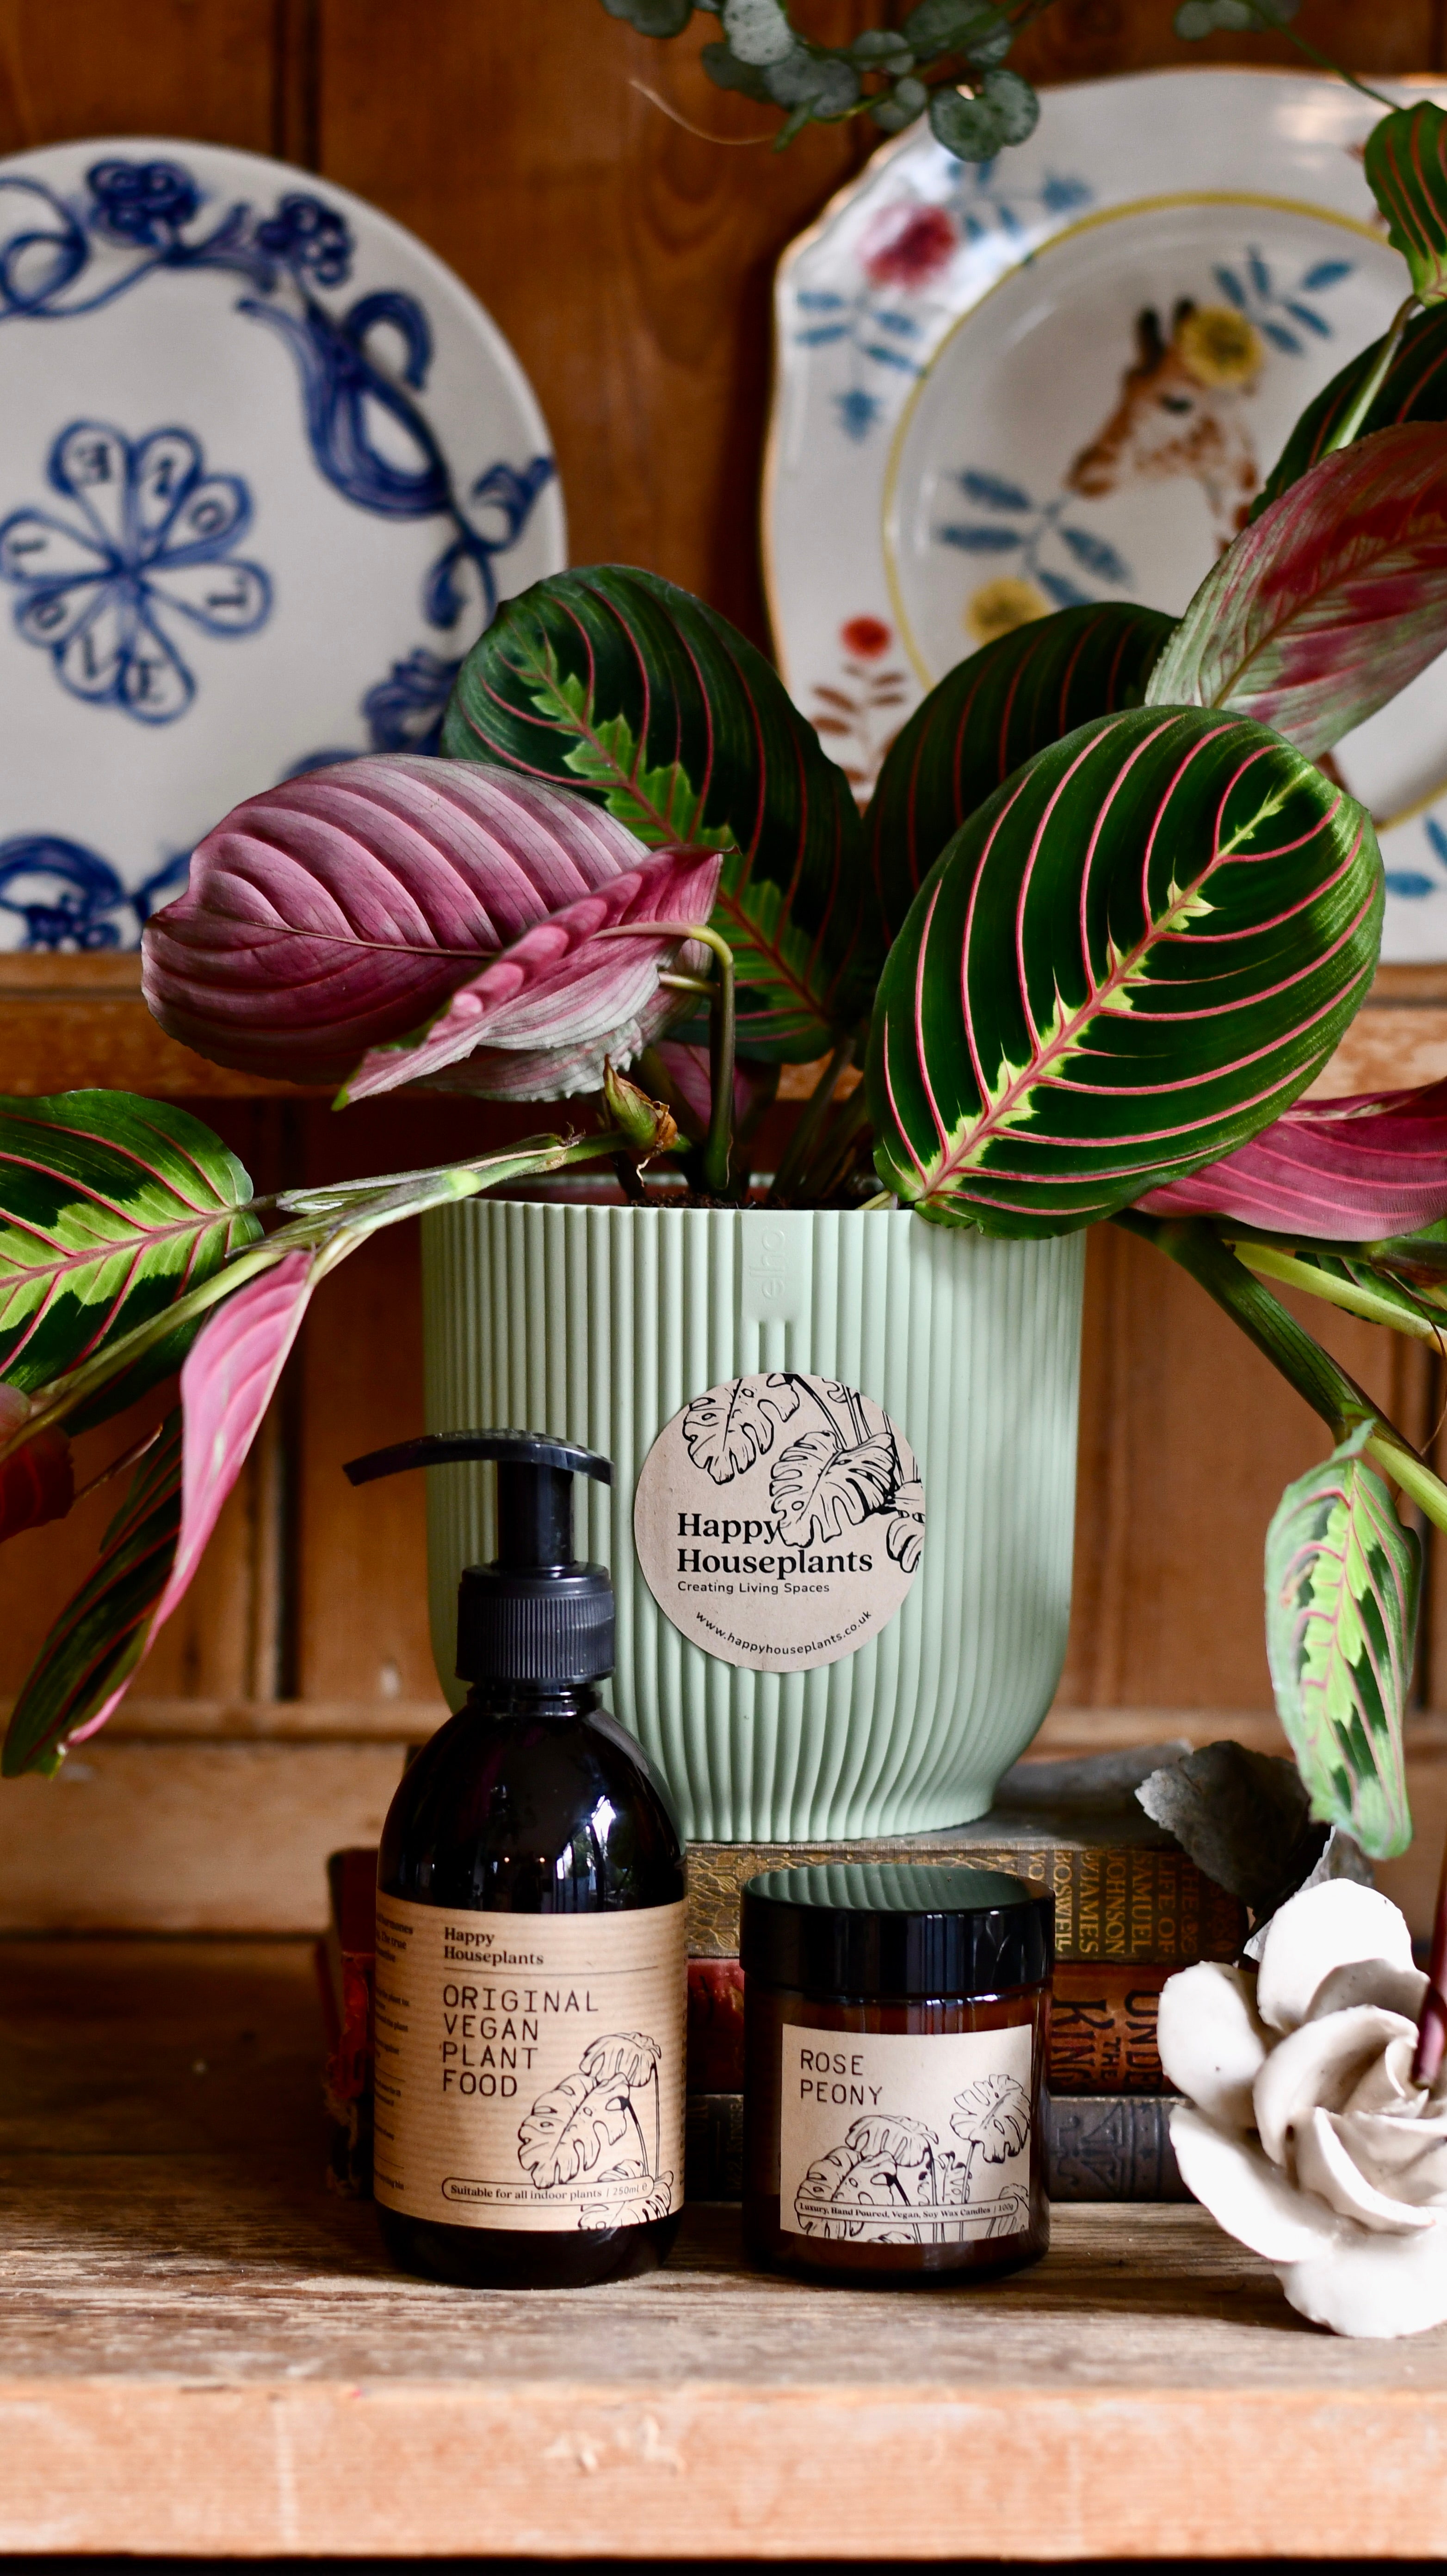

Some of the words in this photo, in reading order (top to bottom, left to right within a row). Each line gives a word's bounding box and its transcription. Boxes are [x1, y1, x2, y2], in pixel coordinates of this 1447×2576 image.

[749, 1228, 785, 1300] elho
[677, 1512, 780, 1544] Happy
[677, 1548, 873, 1580] Houseplants
[678, 1580, 734, 1595] Creating
[739, 1582, 779, 1595] Living
[784, 1582, 829, 1594] Spaces
[696, 1610, 872, 1655] www.happyhouseplants.co.uk
[1028, 1852, 1045, 1881] VO
[1158, 1855, 1176, 1911] LIFE
[1106, 1850, 1126, 1954] JOHNSON
[1132, 1851, 1153, 1953] SAMUEL
[444, 1926, 495, 1947] Happy
[1158, 1917, 1175, 1954] OF
[444, 1945, 544, 1966] Houseplants
[443, 1984, 599, 2012] ORIGINAL
[443, 2012, 539, 2042] VEGAN
[442, 2041, 538, 2070] PLANT
[800, 2048, 864, 2076] ROSE
[1101, 2037, 1121, 2082] THE
[443, 2069, 518, 2098] FOOD
[800, 2079, 883, 2106] PEONY
[451, 2184, 494, 2198] Suitable
[495, 2188, 512, 2199] for
[514, 2189, 527, 2199] all
[530, 2189, 568, 2200] indoor
[570, 2189, 602, 2201] plants
[612, 2185, 640, 2197] 250ml
[799, 2202, 830, 2215] Luxury,
[831, 2207, 853, 2217] Hand
[855, 2208, 890, 2219] Poured,
[891, 2210, 921, 2220] Vegan,
[922, 2210, 939, 2219] Soy
[940, 2209, 958, 2217] Wax
[960, 2206, 991, 2216] Candles
